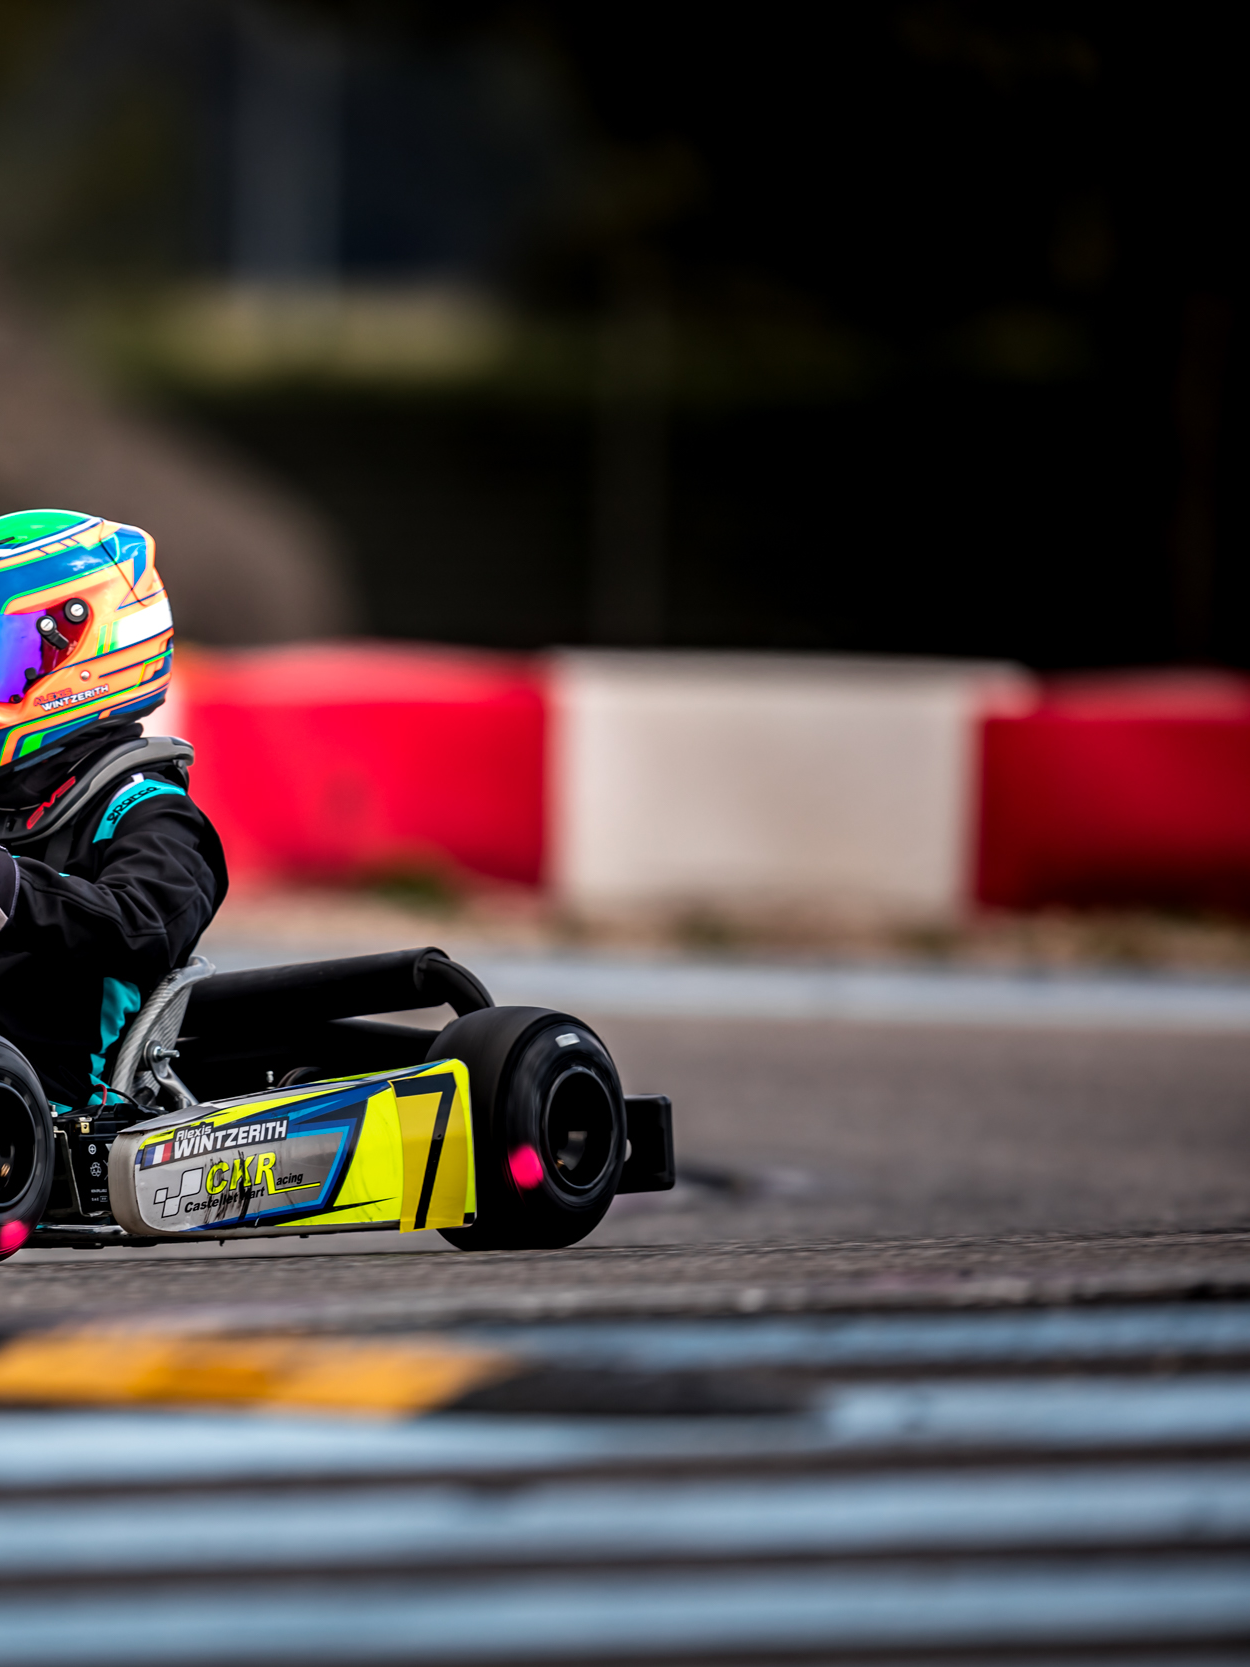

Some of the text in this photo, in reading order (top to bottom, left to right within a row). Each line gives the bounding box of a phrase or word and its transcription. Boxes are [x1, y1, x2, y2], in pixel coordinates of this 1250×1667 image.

[34, 688, 72, 706] ALEXIS
[41, 684, 108, 711] WINTZERITH
[174, 1120, 287, 1159] WINTZERITH
[176, 1125, 212, 1141] Alexis
[391, 1072, 457, 1229] 7
[205, 1152, 277, 1195] CKR
[184, 1192, 238, 1213] Castellet
